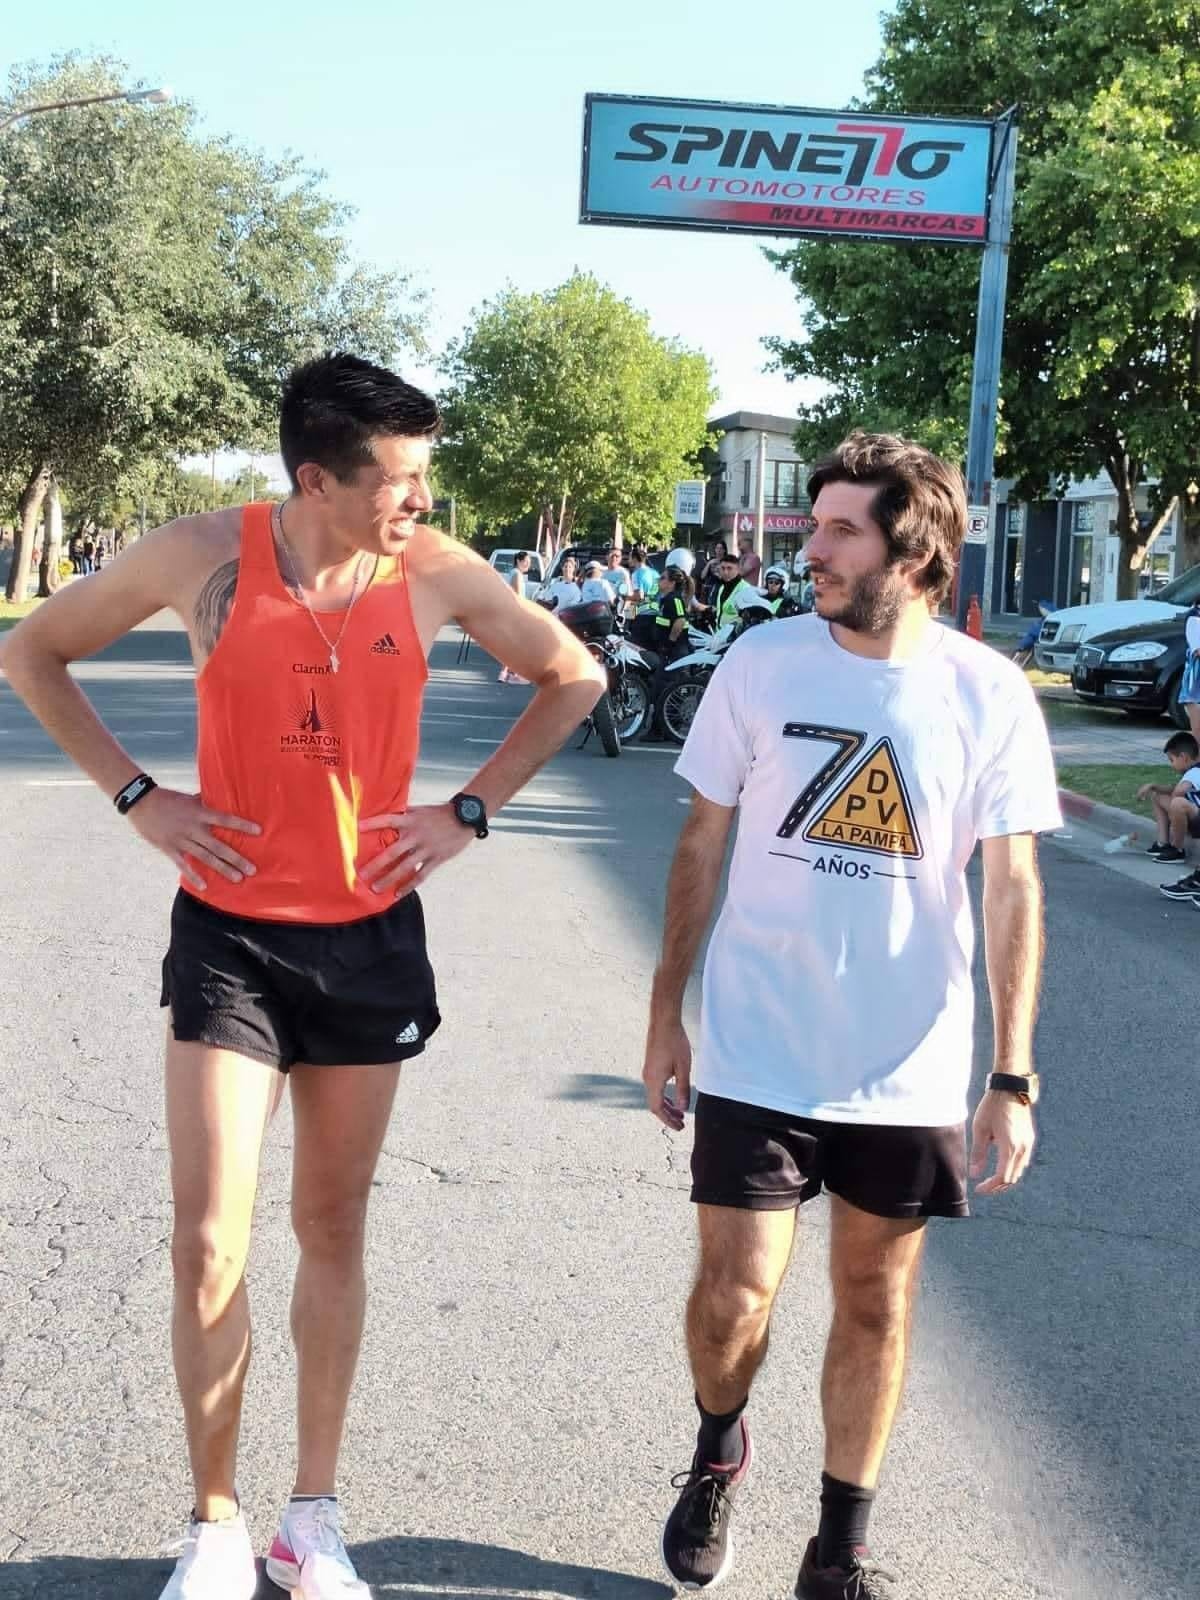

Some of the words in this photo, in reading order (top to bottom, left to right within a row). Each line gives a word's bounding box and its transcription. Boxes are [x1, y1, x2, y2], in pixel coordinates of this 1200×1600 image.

[614, 122, 965, 187] SPINETTO
[650, 174, 926, 206] AUTOMOTORES
[769, 205, 976, 233] MULTIMARCAS
[973, 519, 982, 531] E
[867, 768, 890, 795] D
[845, 794, 867, 818] P
[877, 799, 898, 826] V
[821, 822, 845, 840] LA
[850, 827, 907, 850] PAMPA
[812, 854, 872, 880] AÑOS
